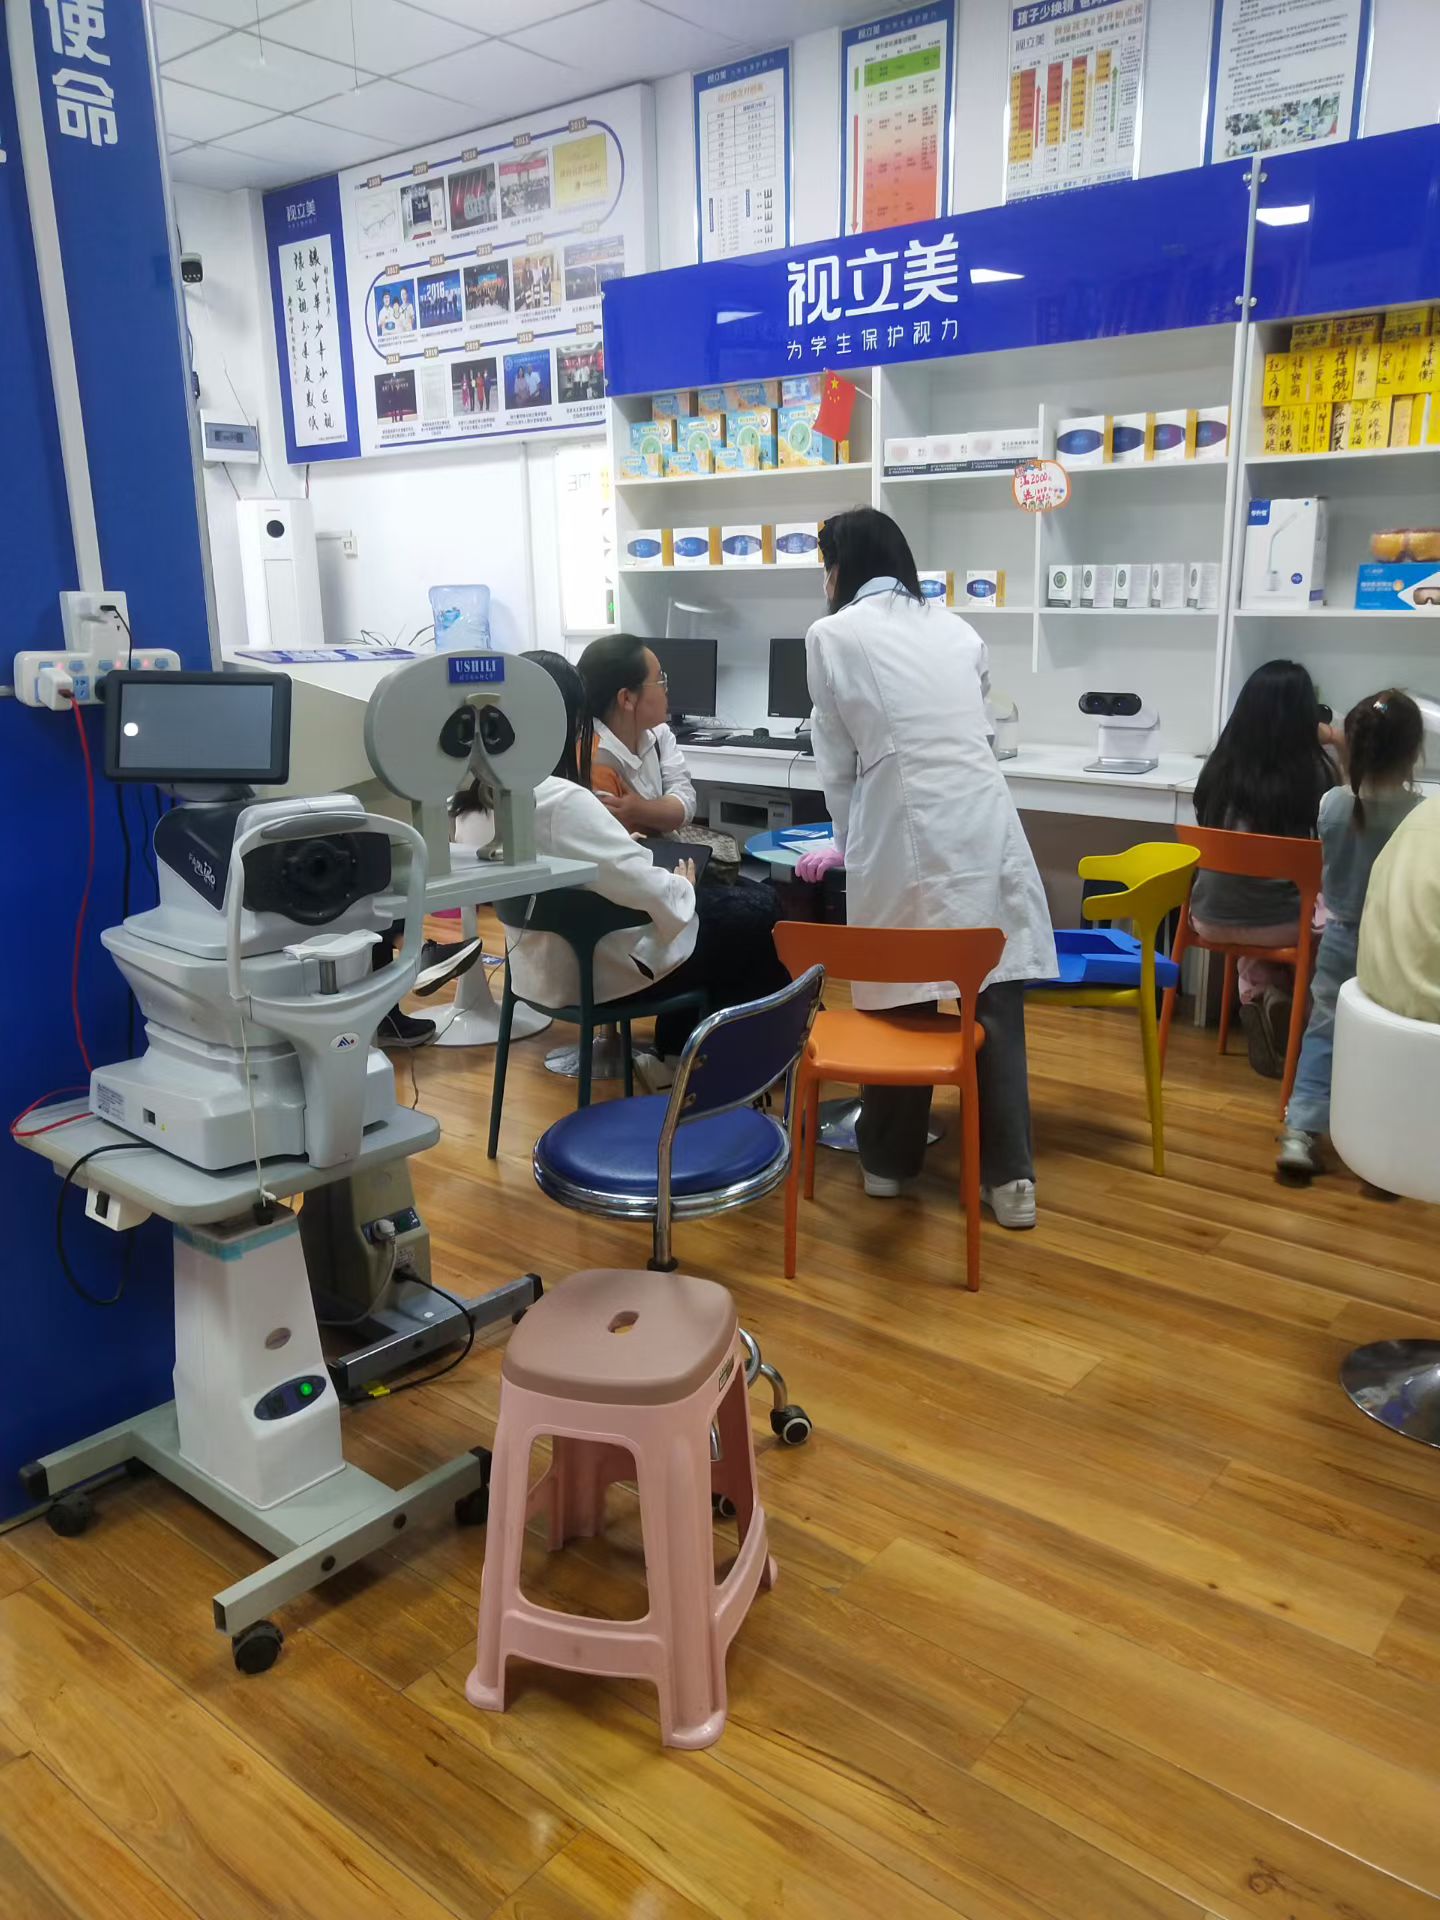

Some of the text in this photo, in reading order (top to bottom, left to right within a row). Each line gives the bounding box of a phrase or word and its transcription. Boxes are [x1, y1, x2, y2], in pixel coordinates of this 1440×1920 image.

[44, 0, 119, 146] 使命
[426, 281, 445, 302] 2016
[787, 232, 959, 327] 视立美
[786, 318, 959, 361] 为学生保护视力
[455, 659, 497, 673] USHILI
